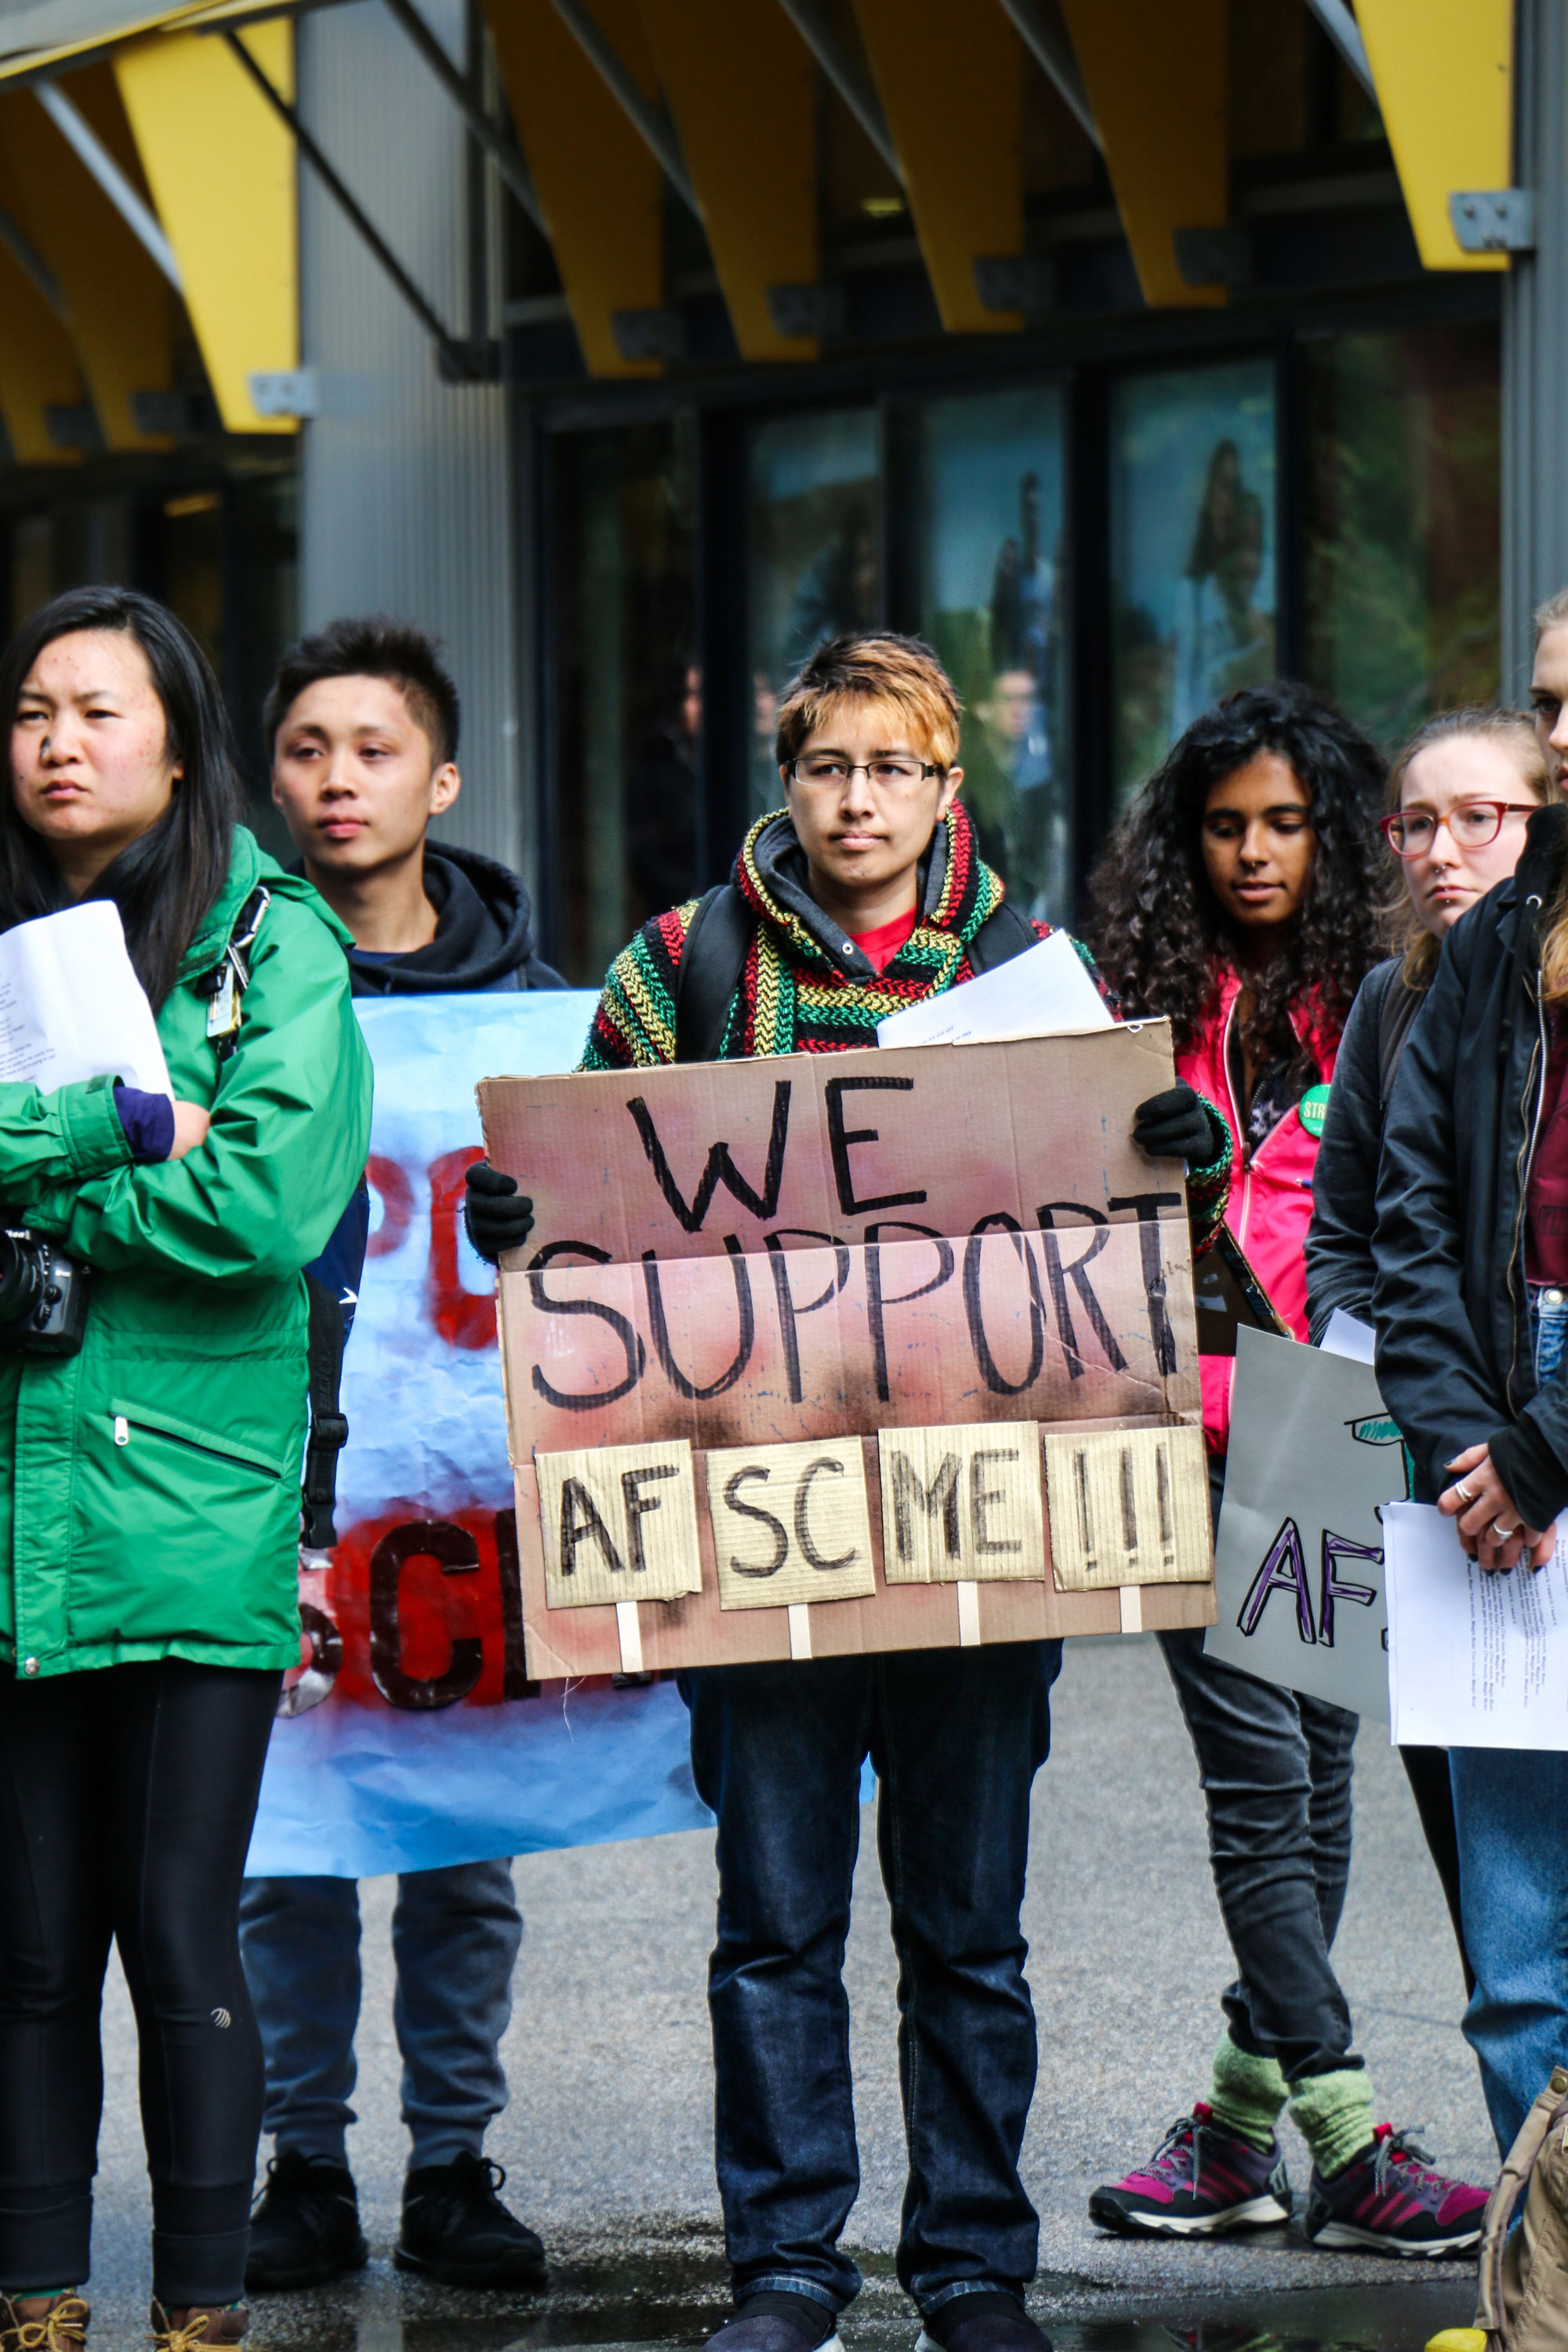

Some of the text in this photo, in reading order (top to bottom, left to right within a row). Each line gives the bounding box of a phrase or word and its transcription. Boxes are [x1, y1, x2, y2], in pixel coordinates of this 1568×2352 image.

[626, 1076, 928, 1232] WE
[1303, 1101, 1327, 1120] STR
[525, 1192, 1183, 1412] SUPPORT
[560, 1465, 680, 1578] AF
[722, 1457, 857, 1579] SC
[887, 1448, 1023, 1563] ME
[1236, 1516, 1388, 1652] AF
